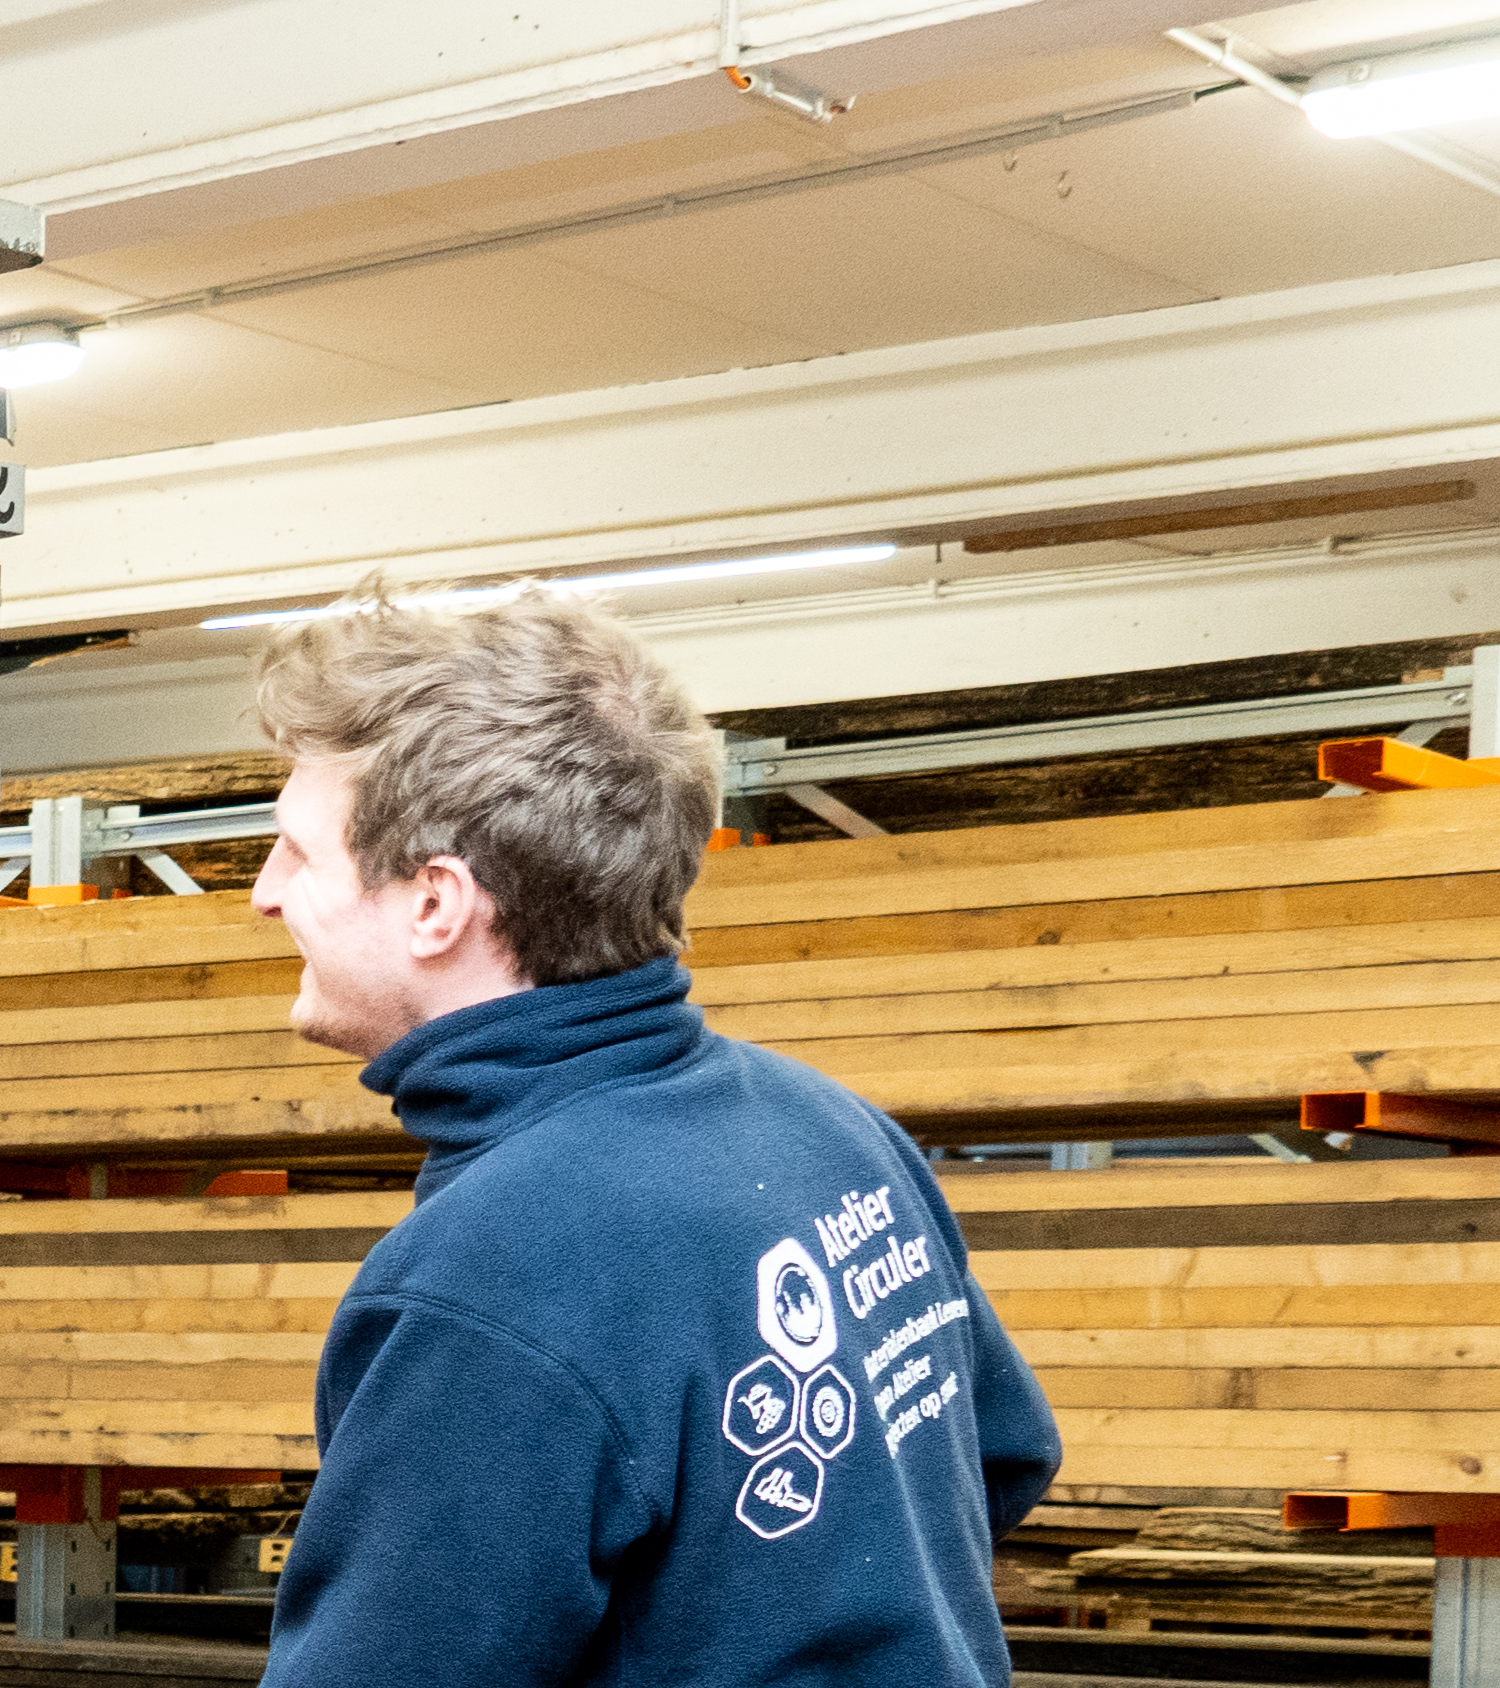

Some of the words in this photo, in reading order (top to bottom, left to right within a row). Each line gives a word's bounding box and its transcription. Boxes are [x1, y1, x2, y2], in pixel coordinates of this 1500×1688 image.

[813, 1185, 895, 1268] Atelier
[842, 1236, 931, 1320] Circuler
[919, 1391, 942, 1420] op
